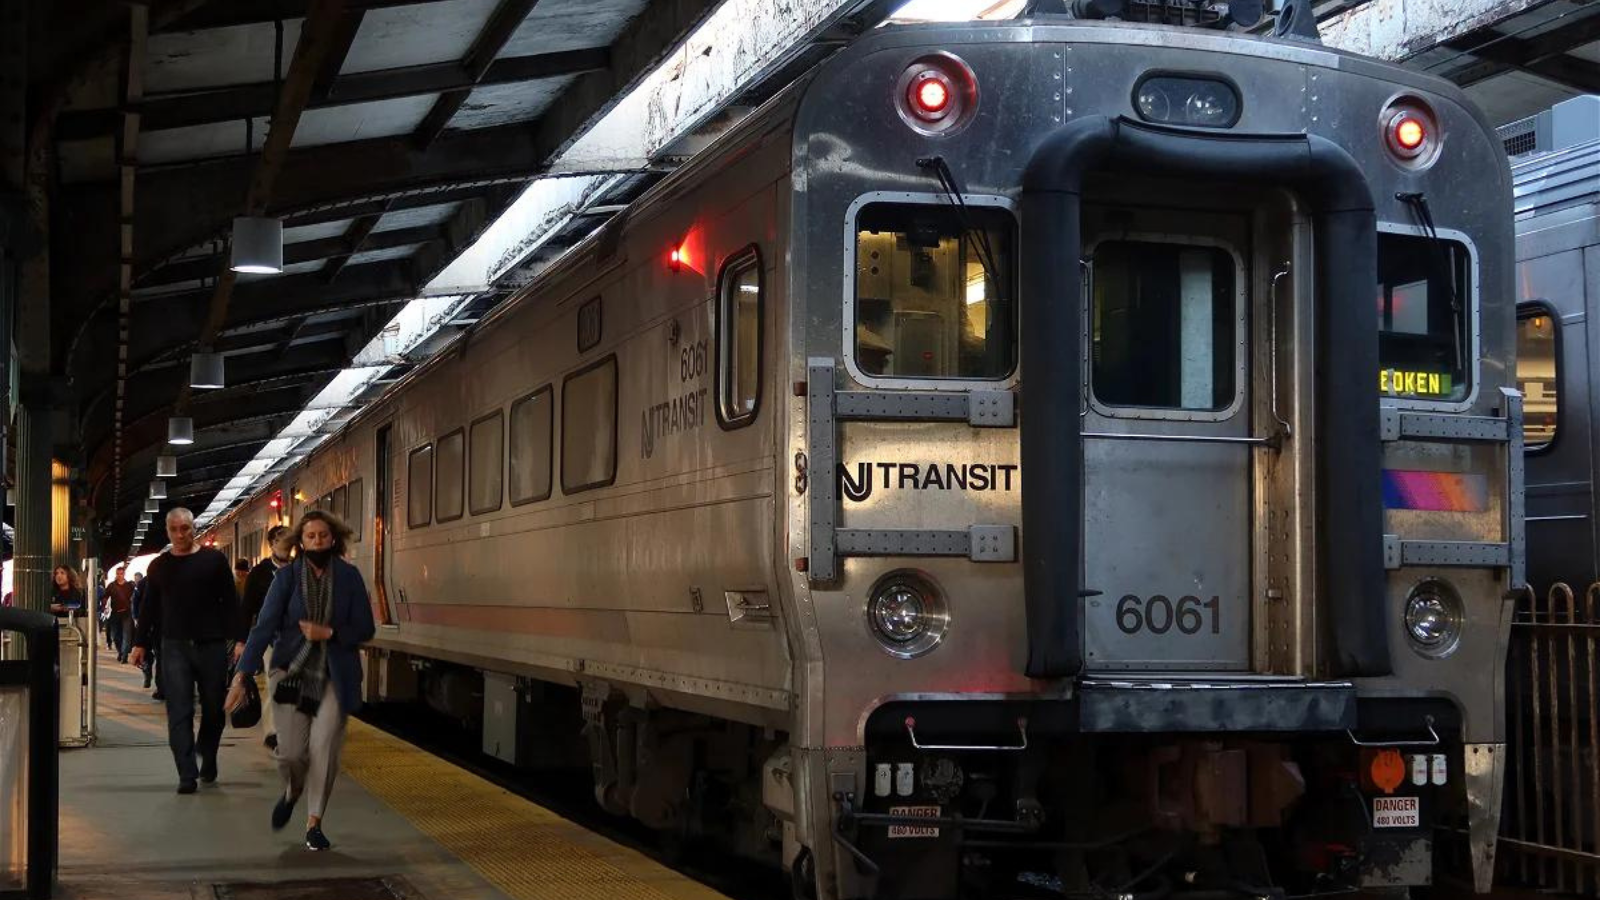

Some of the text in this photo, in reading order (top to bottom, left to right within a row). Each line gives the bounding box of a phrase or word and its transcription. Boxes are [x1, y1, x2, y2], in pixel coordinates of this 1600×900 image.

[680, 338, 708, 383] 6061
[877, 462, 1018, 491] TRANSIT
[1115, 594, 1220, 635] 6061
[1375, 799, 1417, 811] DANGER
[891, 808, 938, 819] DANGER
[1376, 815, 1416, 825] 480 VOLTS
[891, 825, 936, 835] 480 VOLTS
